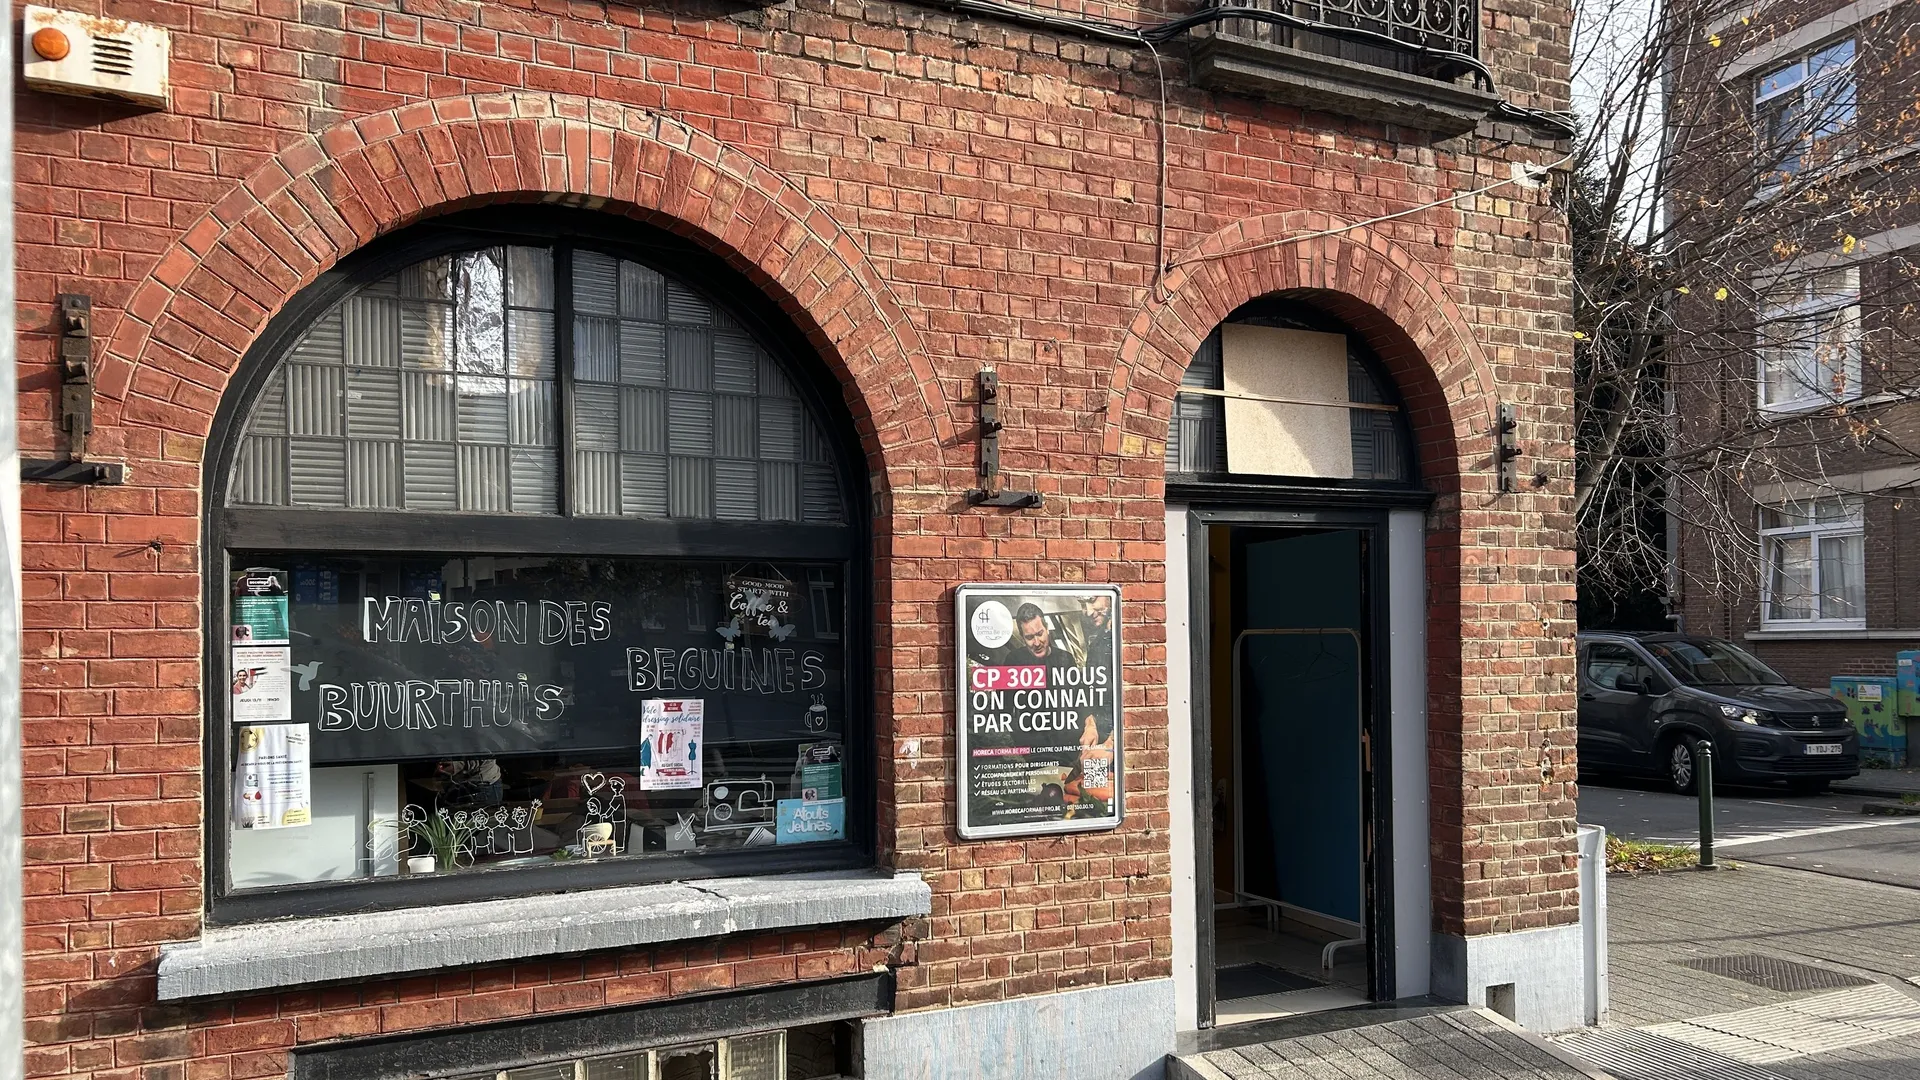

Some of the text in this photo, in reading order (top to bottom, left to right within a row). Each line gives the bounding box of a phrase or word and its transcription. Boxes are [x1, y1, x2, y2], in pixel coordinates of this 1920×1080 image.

[742, 580, 785, 590] GOOD MOOD
[768, 589, 789, 598] WITH
[729, 592, 789, 617] Coffe &
[539, 600, 612, 646] DES
[972, 666, 1107, 689] CP 302 NOUS
[972, 686, 1107, 711] ON CONNAÎT
[671, 712, 700, 723] solidaire
[973, 711, 1079, 734] PAR CŒUR
[973, 749, 994, 757] HORECA
[793, 805, 829, 821] Atouts
